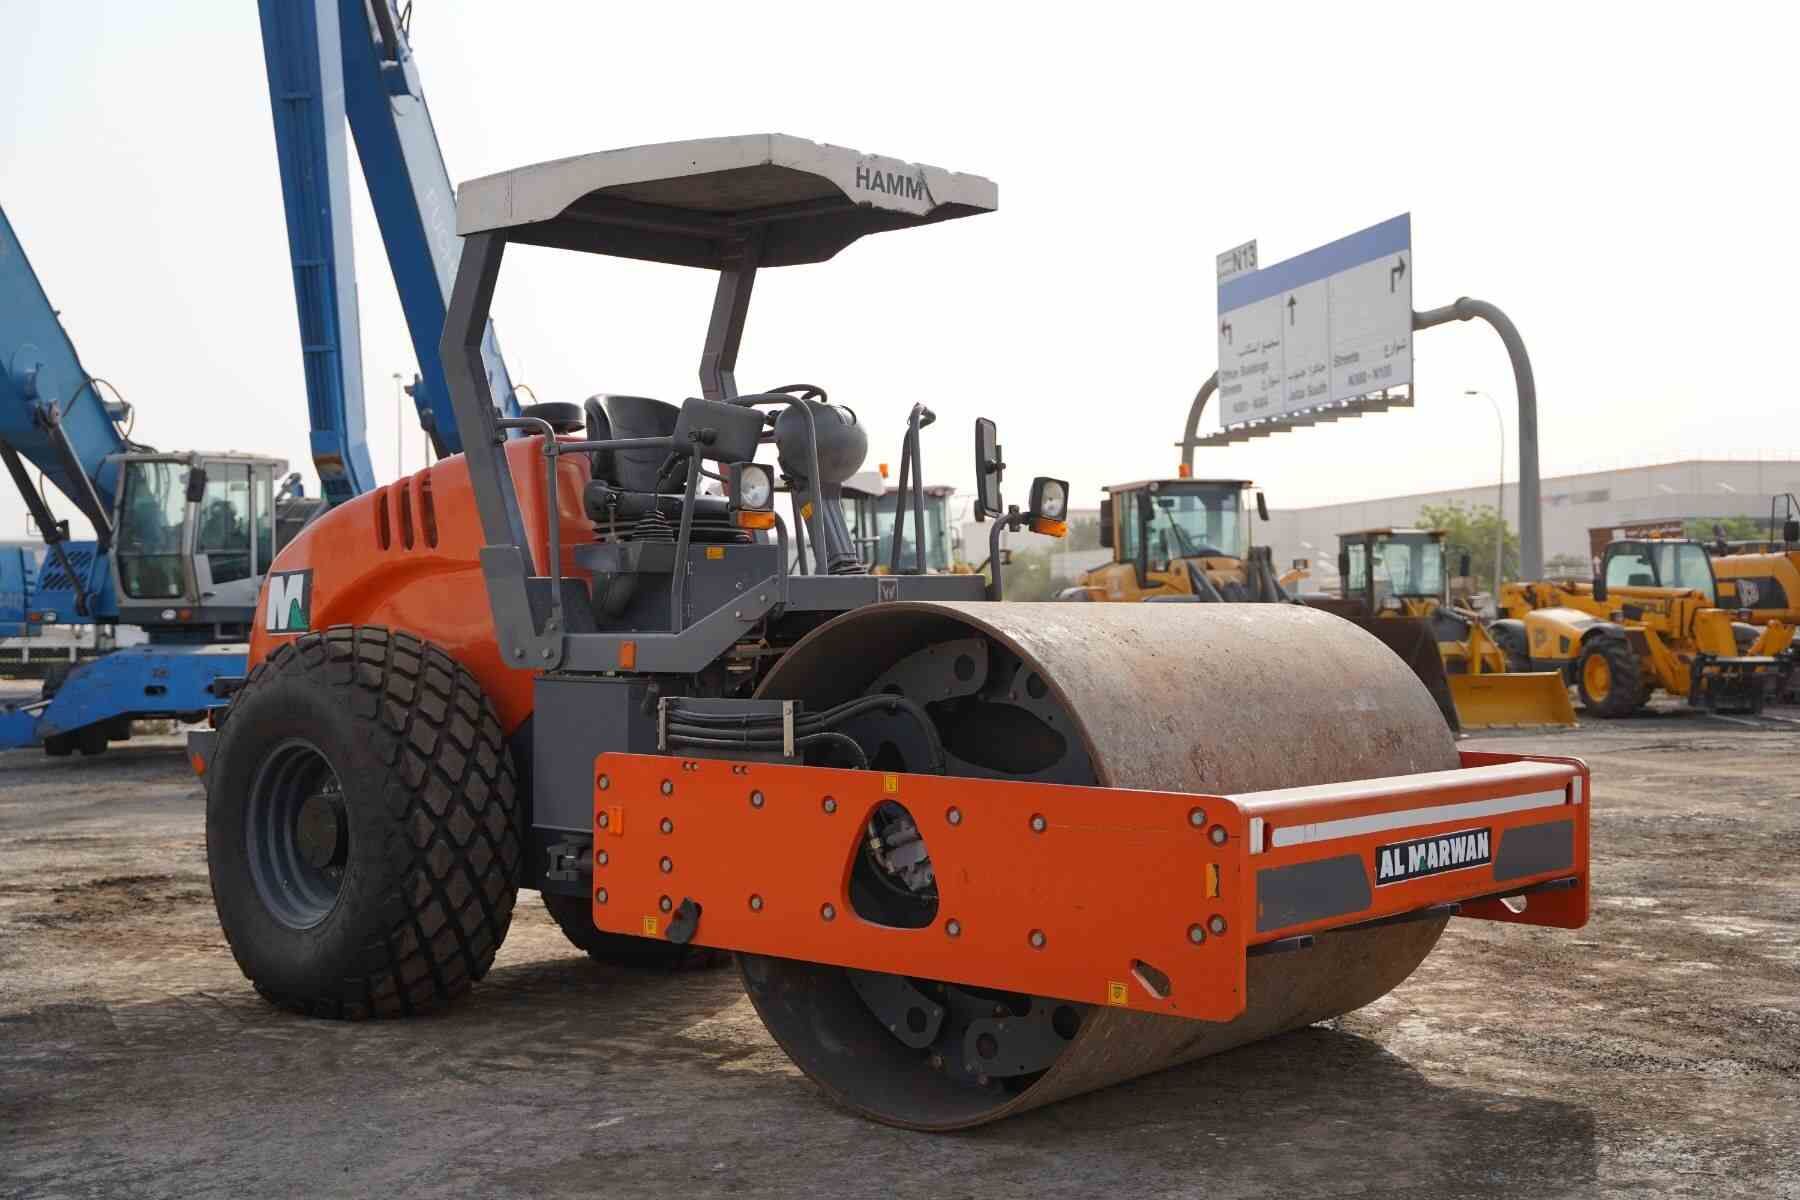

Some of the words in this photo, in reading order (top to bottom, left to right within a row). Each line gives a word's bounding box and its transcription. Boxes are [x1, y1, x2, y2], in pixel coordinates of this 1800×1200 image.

[856, 166, 923, 201] HAMM
[1231, 244, 1256, 273] N13
[1380, 848, 1405, 879] AL
[1408, 831, 1489, 874] MARWAN
